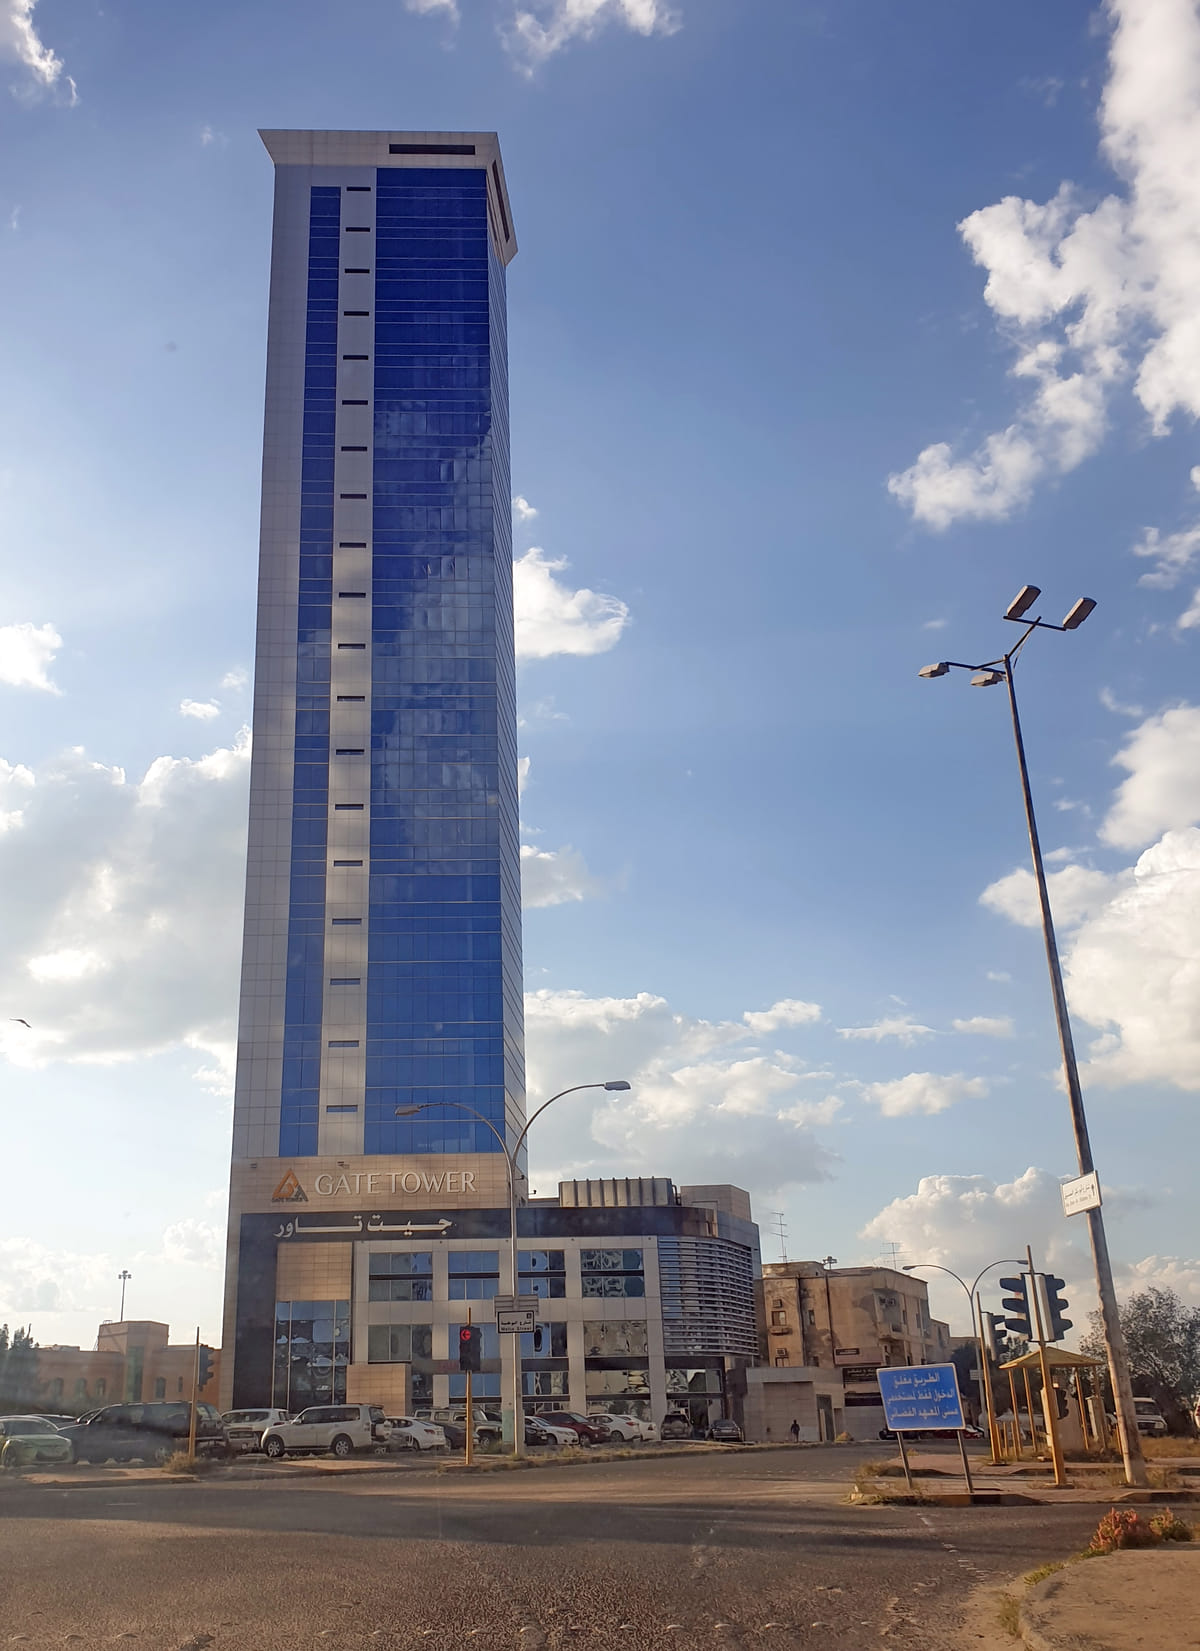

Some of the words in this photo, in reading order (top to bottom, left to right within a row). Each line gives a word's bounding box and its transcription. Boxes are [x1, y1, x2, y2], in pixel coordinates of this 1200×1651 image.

[314, 1173, 382, 1196] GATE
[387, 1171, 477, 1195] TOWER
[273, 1215, 362, 1238] تاور
[367, 1214, 453, 1236] جيت
[893, 1374, 912, 1389] مغلق
[913, 1371, 940, 1387] الطريق
[917, 1390, 932, 1400] فقط
[933, 1388, 954, 1402] الدخول
[918, 1405, 940, 1420] المعهد
